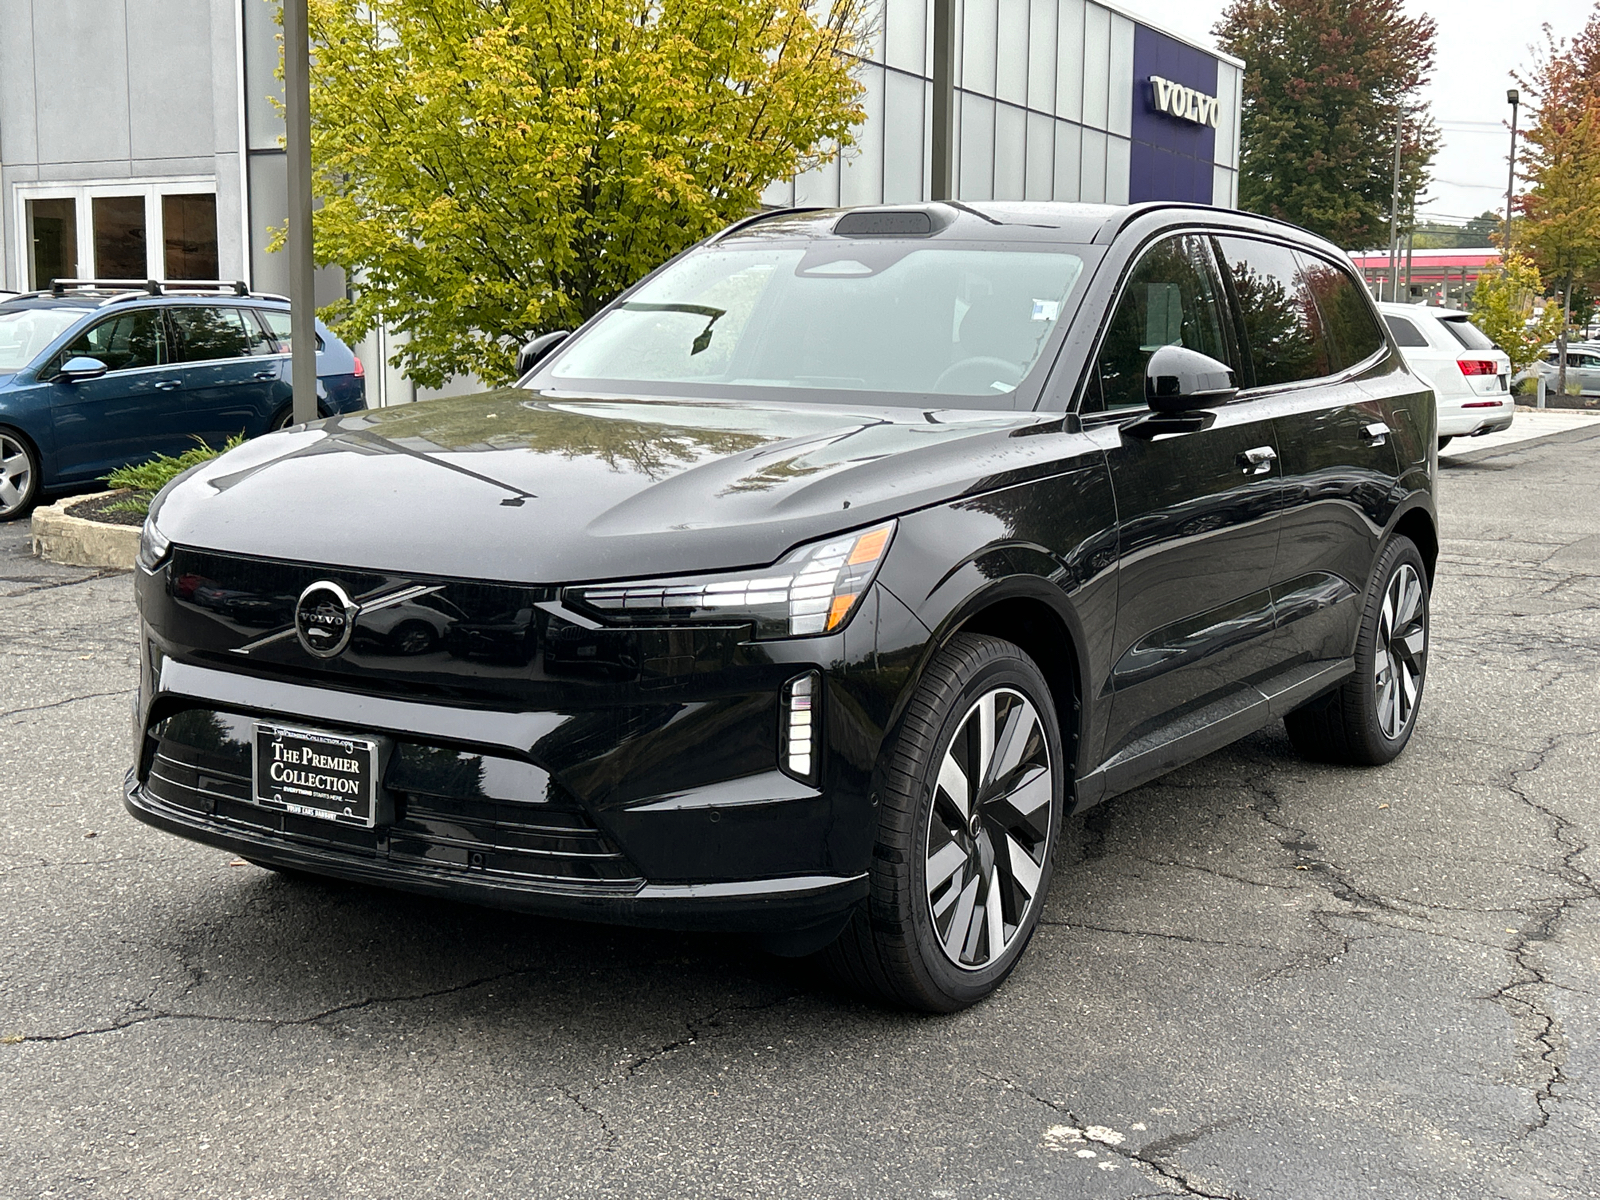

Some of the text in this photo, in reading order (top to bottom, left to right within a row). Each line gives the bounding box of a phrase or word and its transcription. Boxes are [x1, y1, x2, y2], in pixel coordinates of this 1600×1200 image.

[1149, 76, 1221, 129] VOLVO
[301, 612, 344, 626] VOLVO
[271, 742, 360, 774] THE PREMIER
[270, 762, 360, 795] COLLECTION
[914, 791, 930, 896] MICHELIN
